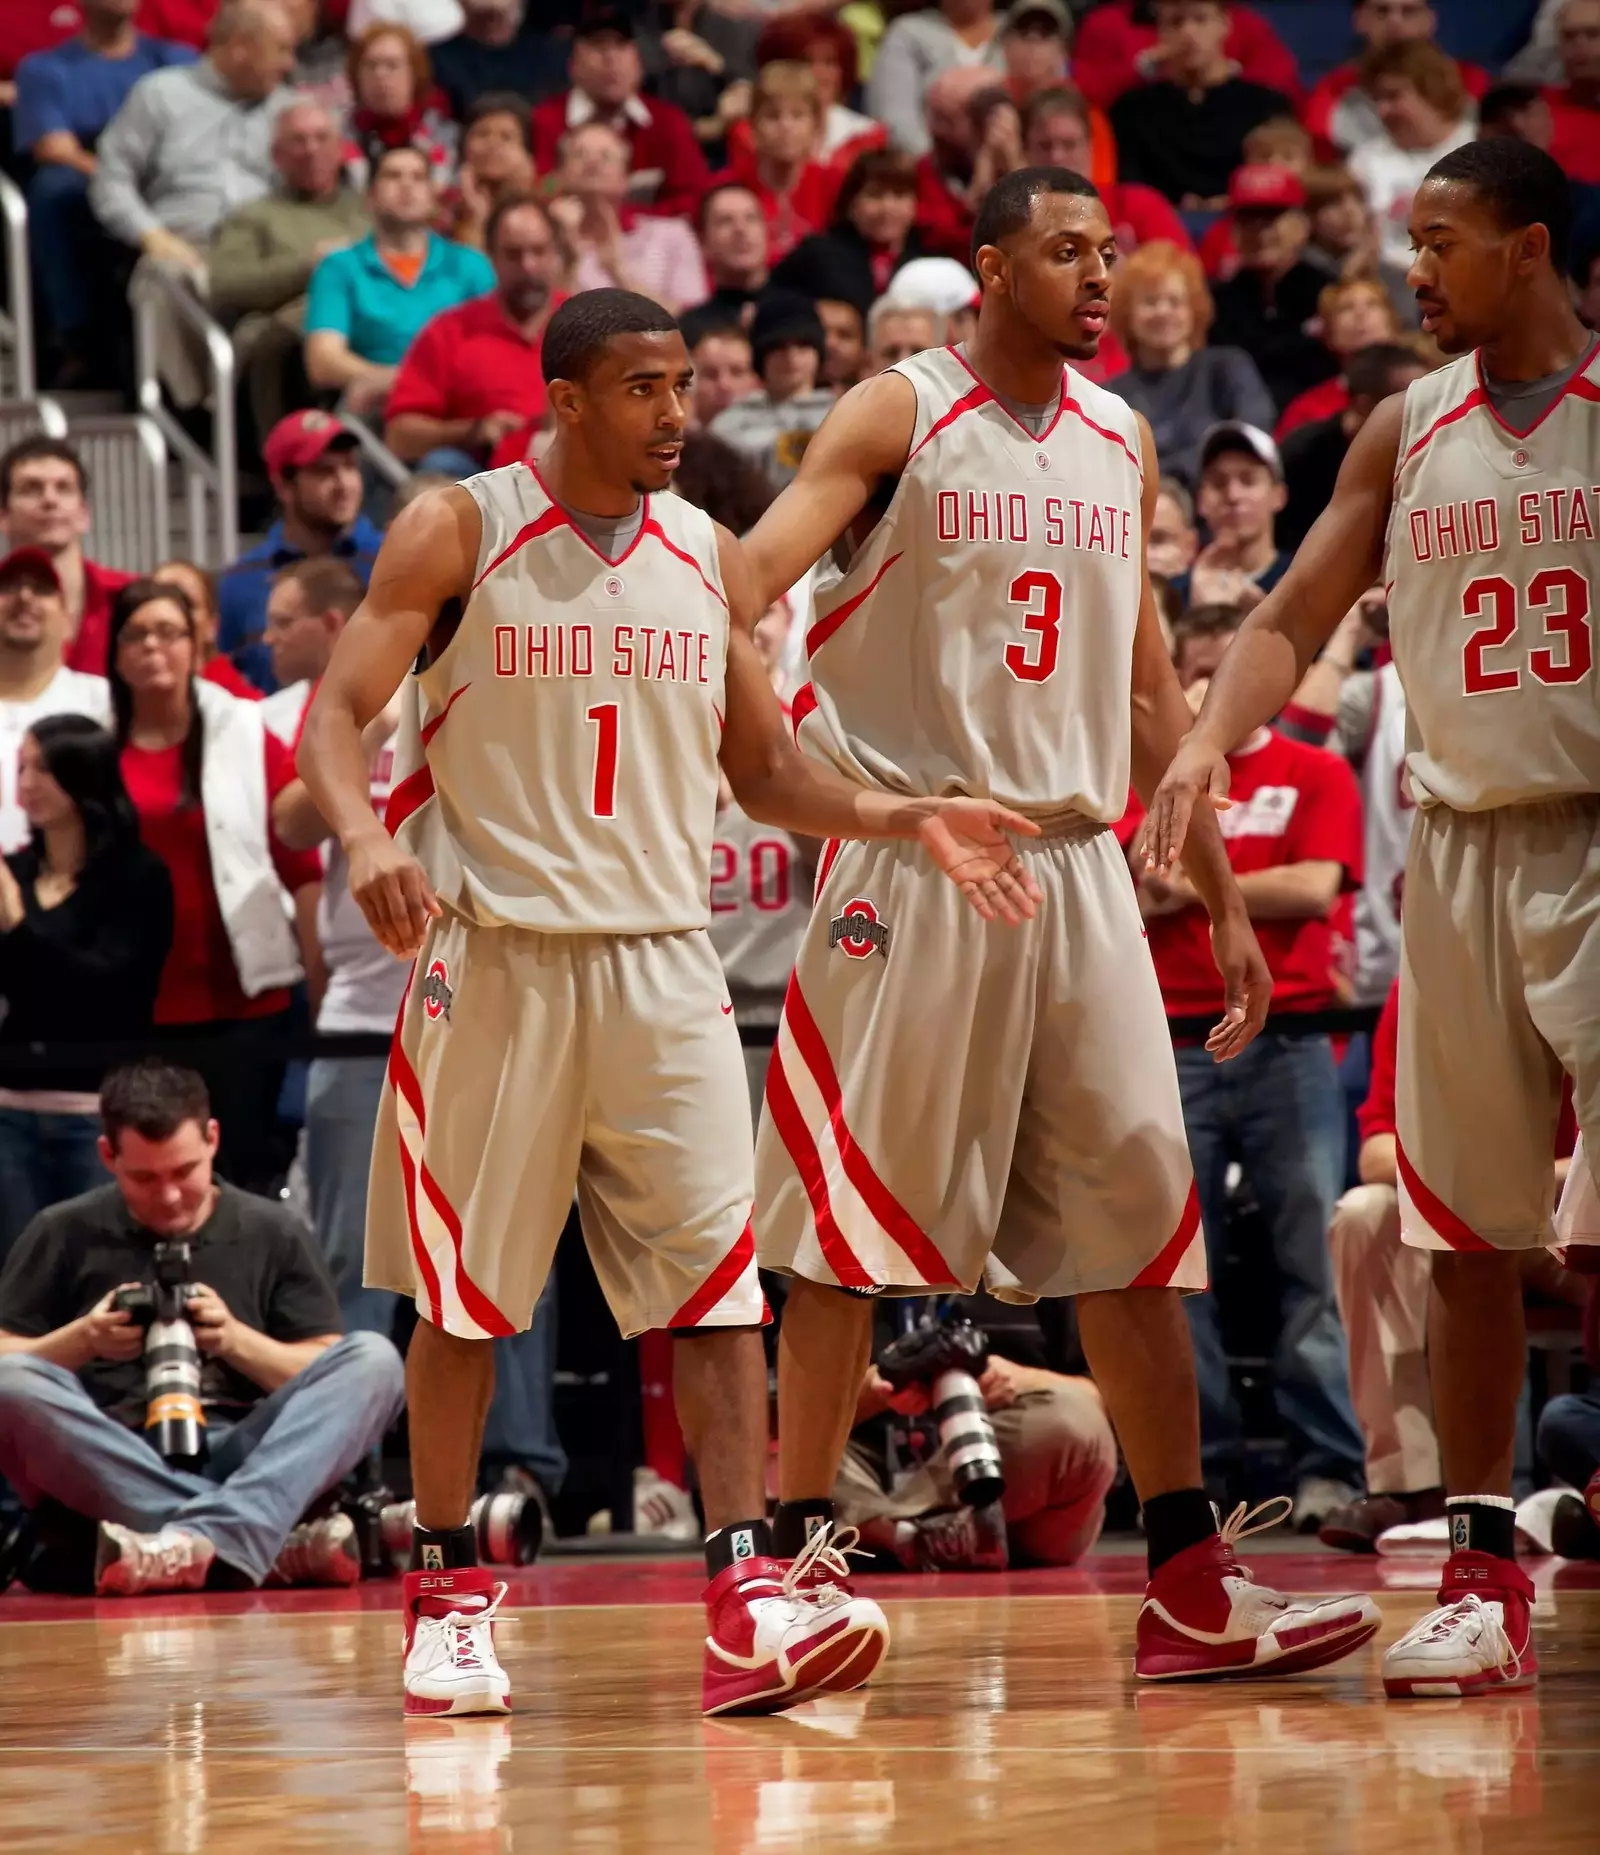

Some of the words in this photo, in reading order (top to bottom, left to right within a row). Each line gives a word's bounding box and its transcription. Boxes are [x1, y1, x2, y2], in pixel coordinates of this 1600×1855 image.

[937, 490, 1029, 543] OHIO
[1044, 496, 1132, 561] STATE
[1409, 498, 1500, 563] OHIO
[493, 624, 594, 678] OHIO
[612, 624, 711, 685] STATE
[1002, 567, 1064, 685] 3
[1461, 565, 1593, 697] 23
[585, 702, 620, 820] 1
